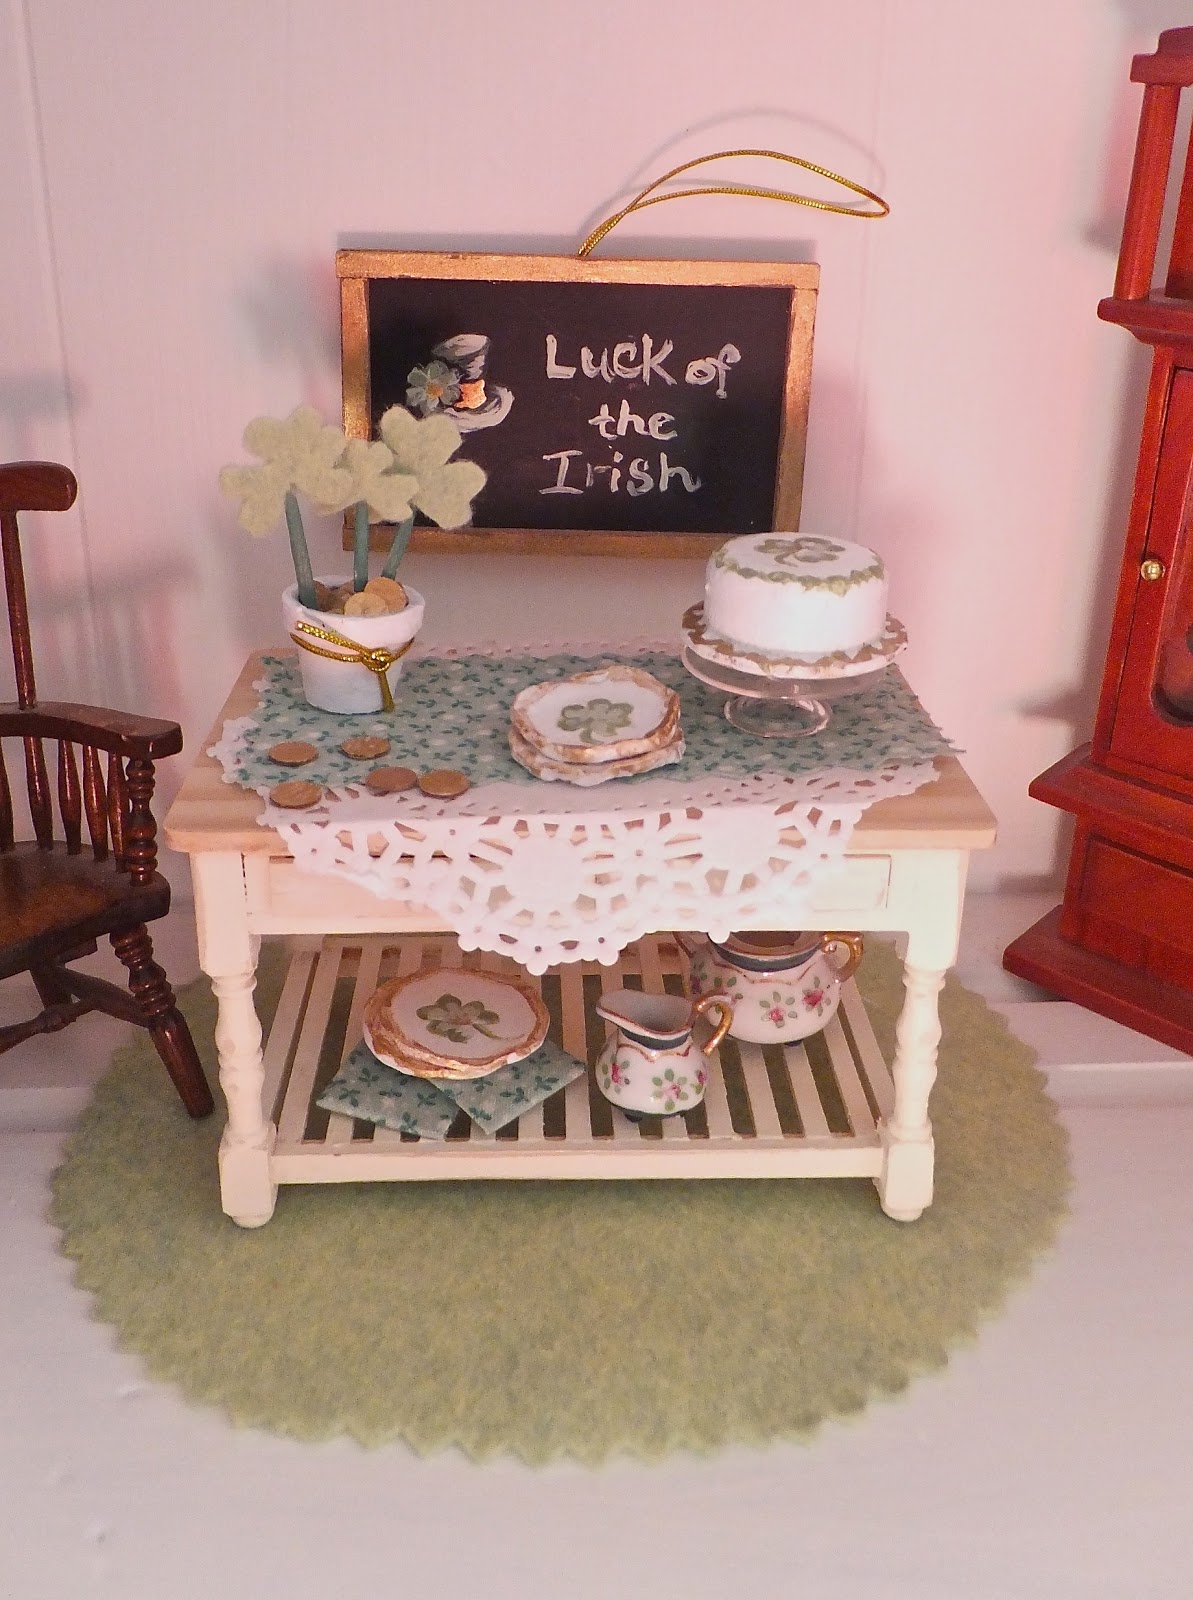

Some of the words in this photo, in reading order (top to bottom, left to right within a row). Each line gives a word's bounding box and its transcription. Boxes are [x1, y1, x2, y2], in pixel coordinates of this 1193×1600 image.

[685, 343, 742, 399] of
[588, 398, 678, 441] the
[538, 449, 702, 497] Irish
